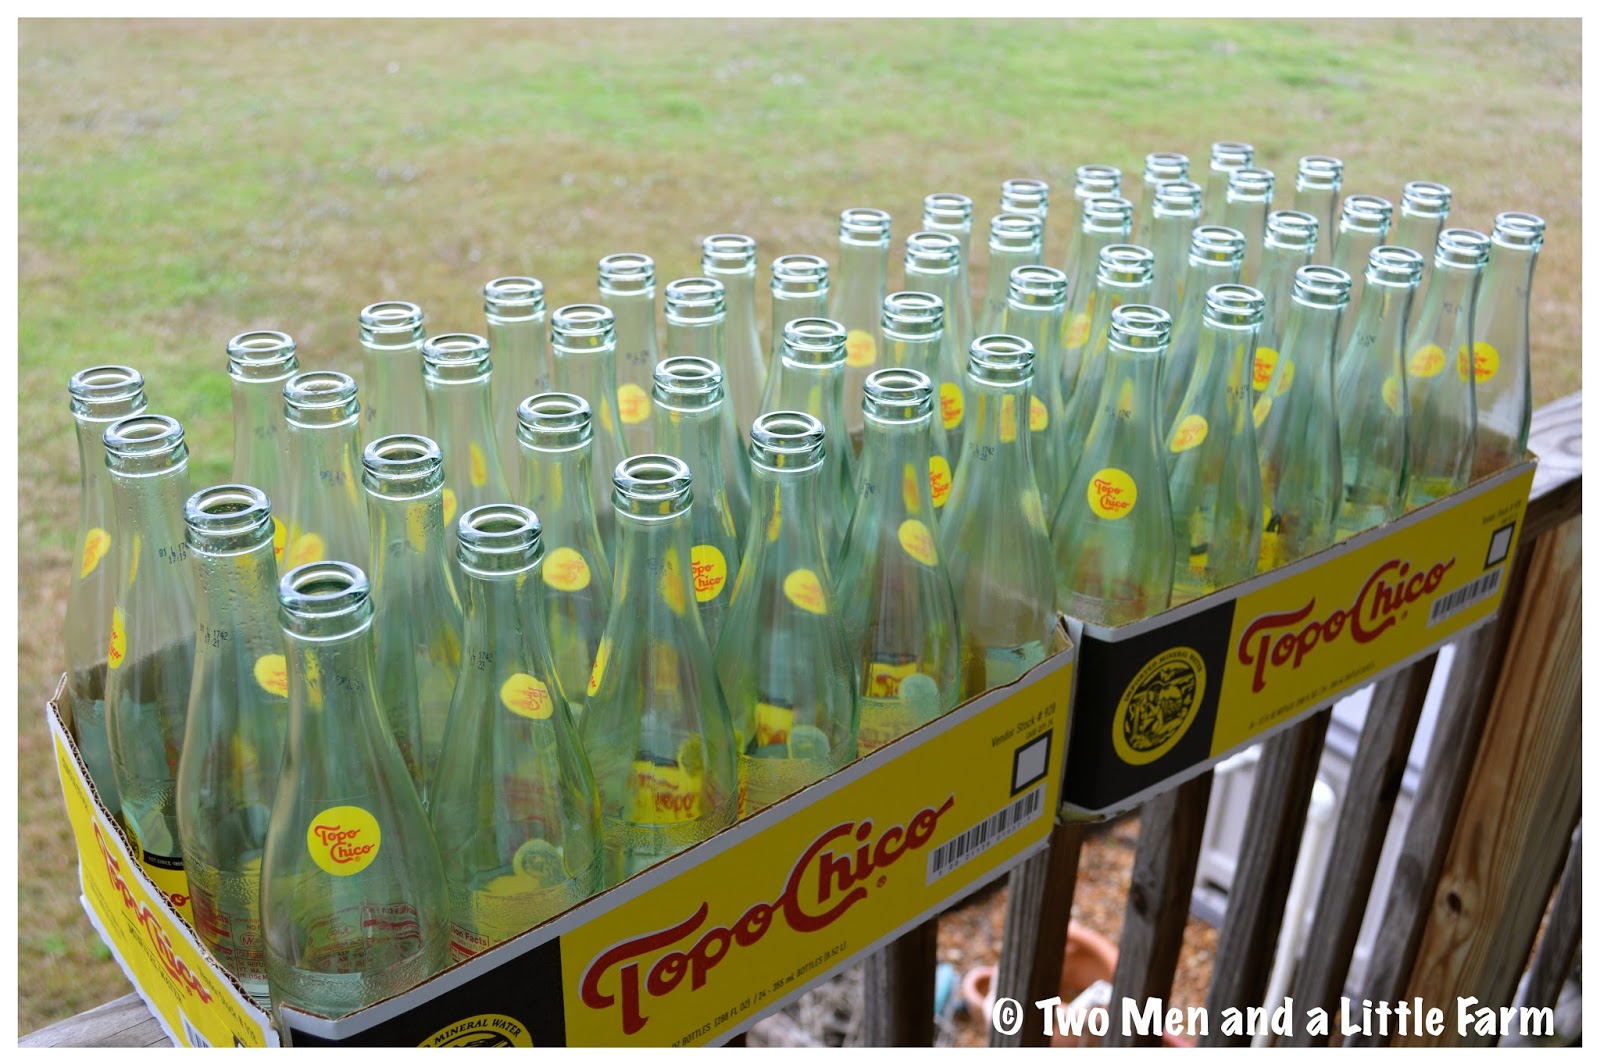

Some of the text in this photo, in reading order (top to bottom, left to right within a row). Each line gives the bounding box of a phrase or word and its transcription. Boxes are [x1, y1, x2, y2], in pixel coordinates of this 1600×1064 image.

[1094, 478, 1124, 496] Topo
[1100, 494, 1130, 510] Chico
[1238, 557, 1456, 692] Topo Chico
[314, 824, 361, 846] Topo
[330, 842, 376, 864] Chico
[576, 792, 956, 1036] Topo Chico
[464, 932, 487, 946] Facts
[682, 1022, 712, 1046] BOTTLES
[730, 1006, 738, 1017] FL
[796, 956, 823, 978] BOTTLES
[434, 1018, 522, 1046] MINERAL WATER
